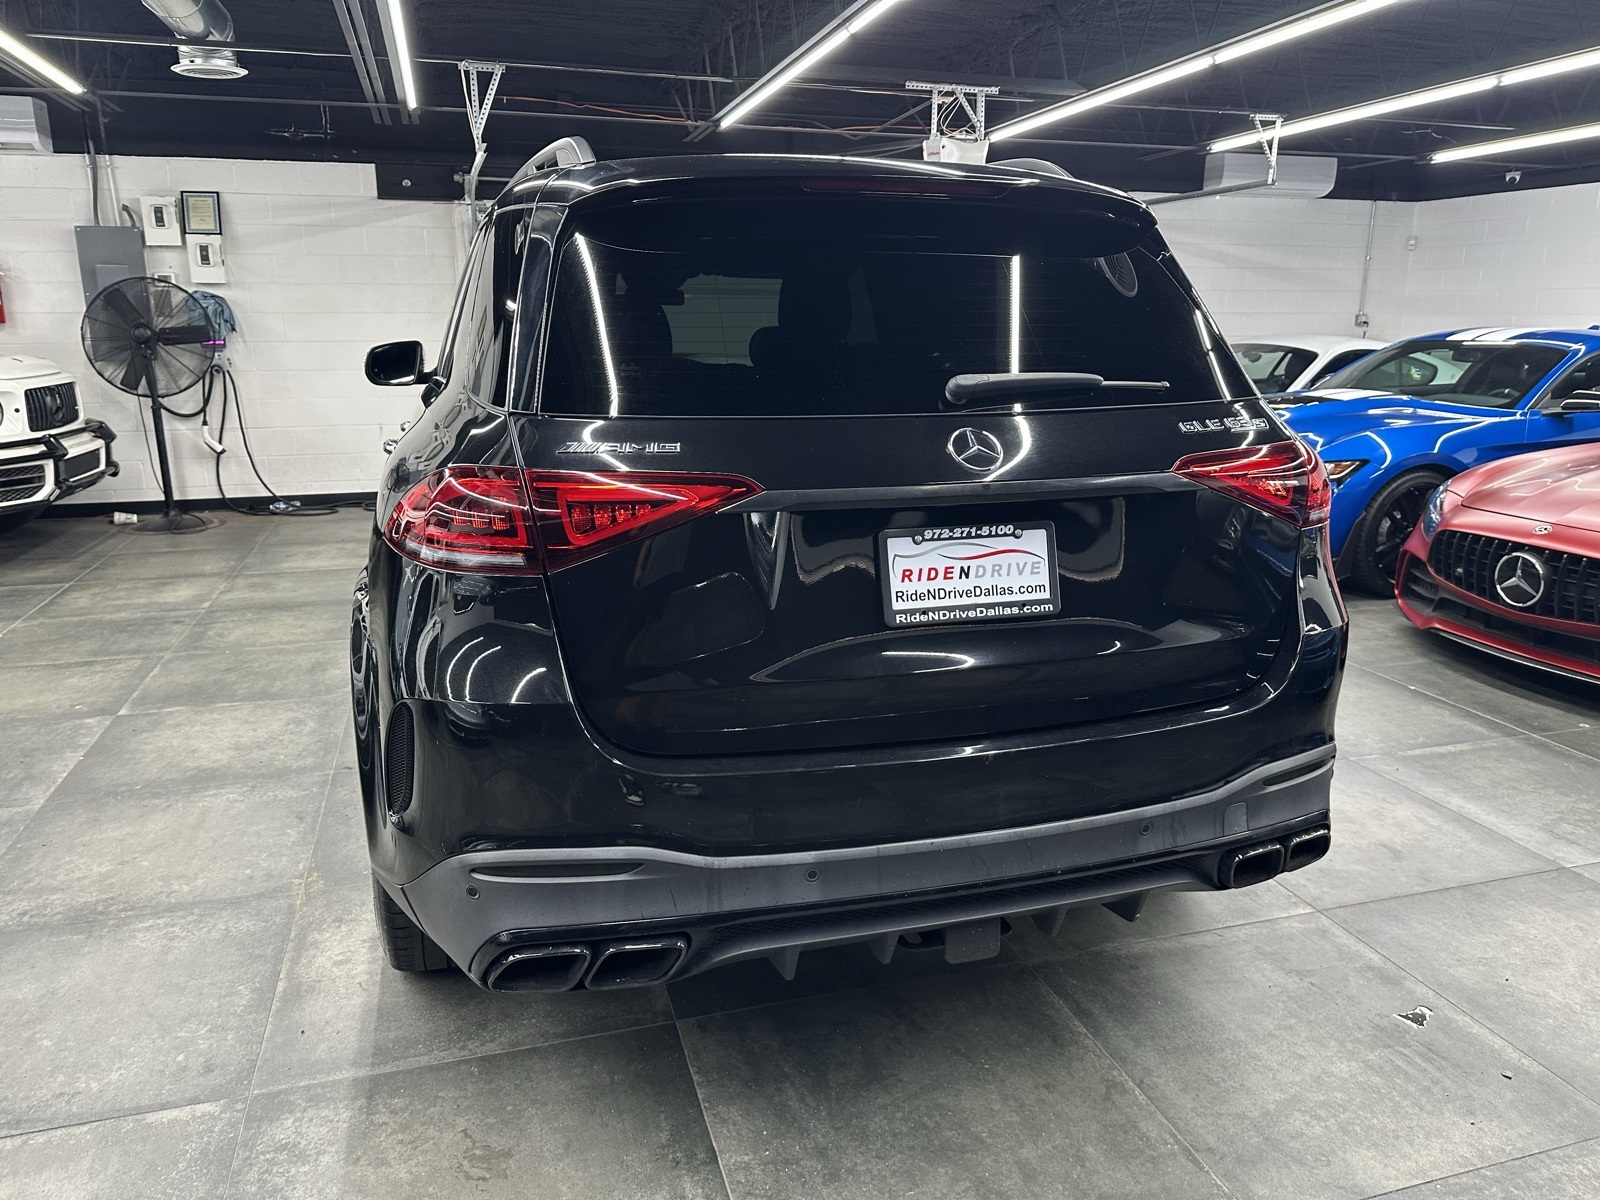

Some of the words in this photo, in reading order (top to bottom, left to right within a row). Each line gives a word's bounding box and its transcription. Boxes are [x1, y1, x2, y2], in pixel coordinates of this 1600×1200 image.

[1178, 419, 1224, 434] GLE
[598, 442, 681, 454] AMG
[923, 525, 1014, 539] 972-271-5100
[895, 584, 1046, 603] RideNDriveDallas.com
[895, 603, 1054, 623] RideNDriveDallas.com
